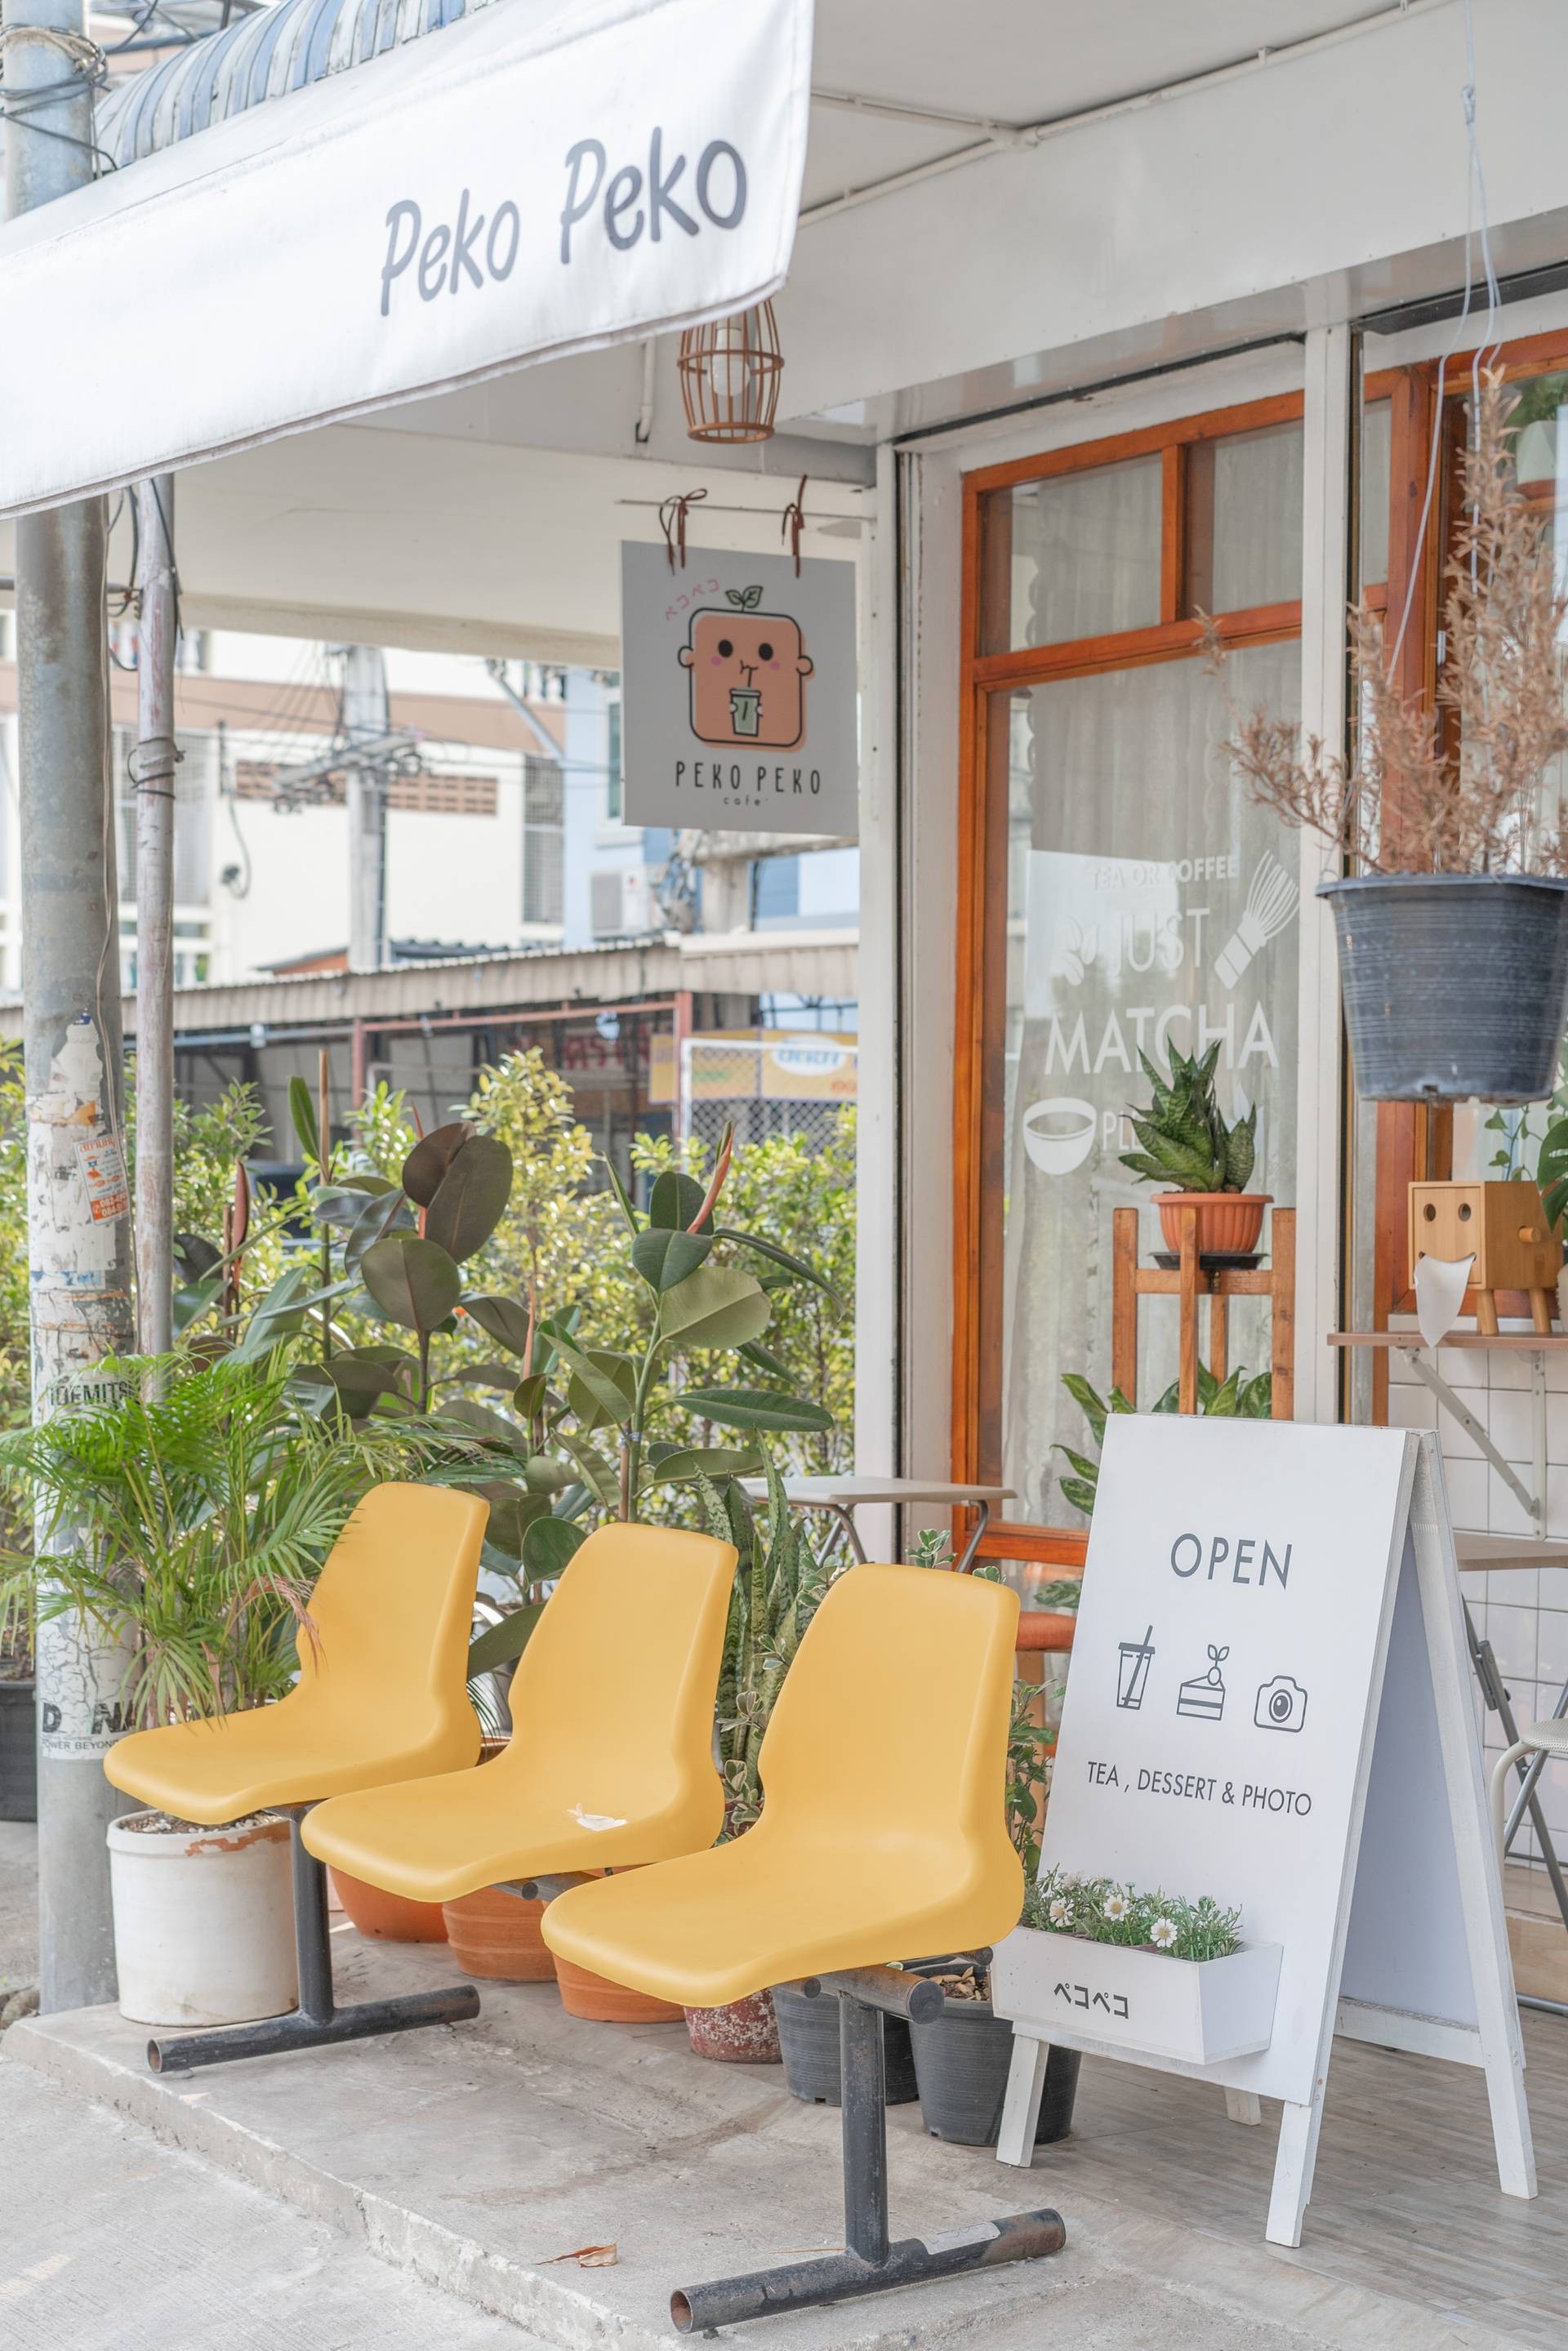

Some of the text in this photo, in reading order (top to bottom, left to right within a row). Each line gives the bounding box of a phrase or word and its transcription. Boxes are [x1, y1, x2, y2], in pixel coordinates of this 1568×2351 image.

[381, 127, 746, 316] Peko Peko
[676, 761, 821, 795] PEKO PEKO
[1109, 907, 1210, 977] JUST
[1045, 1000, 1279, 1075] MATCHA
[1102, 1110, 1145, 1151] PLE
[1170, 1533, 1292, 1589] OPEN
[1138, 1769, 1217, 1801] DESSERT
[1222, 1782, 1235, 1805] &
[1242, 1784, 1312, 1816] PHOTO
[1054, 1983, 1129, 2019] ペコペコ
